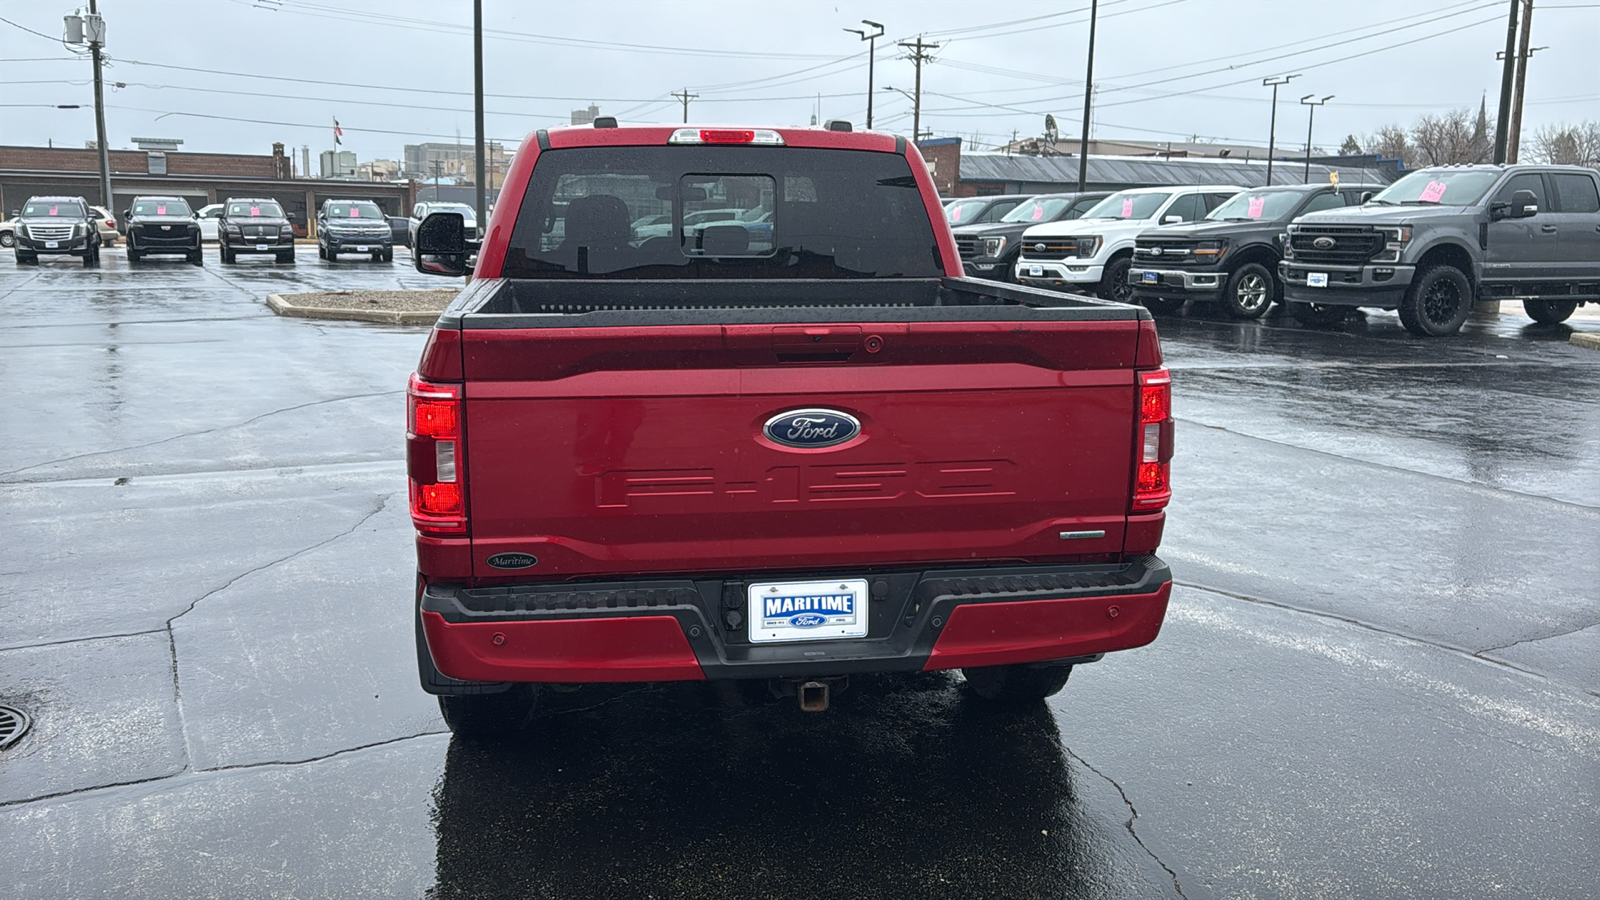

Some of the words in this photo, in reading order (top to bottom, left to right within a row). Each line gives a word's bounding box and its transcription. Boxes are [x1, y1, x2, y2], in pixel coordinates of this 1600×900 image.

[787, 417, 838, 439] Ford
[595, 460, 1017, 508] F-150
[492, 556, 533, 566] Maritime
[766, 595, 852, 617] MARITIME
[795, 616, 820, 626] Ford
